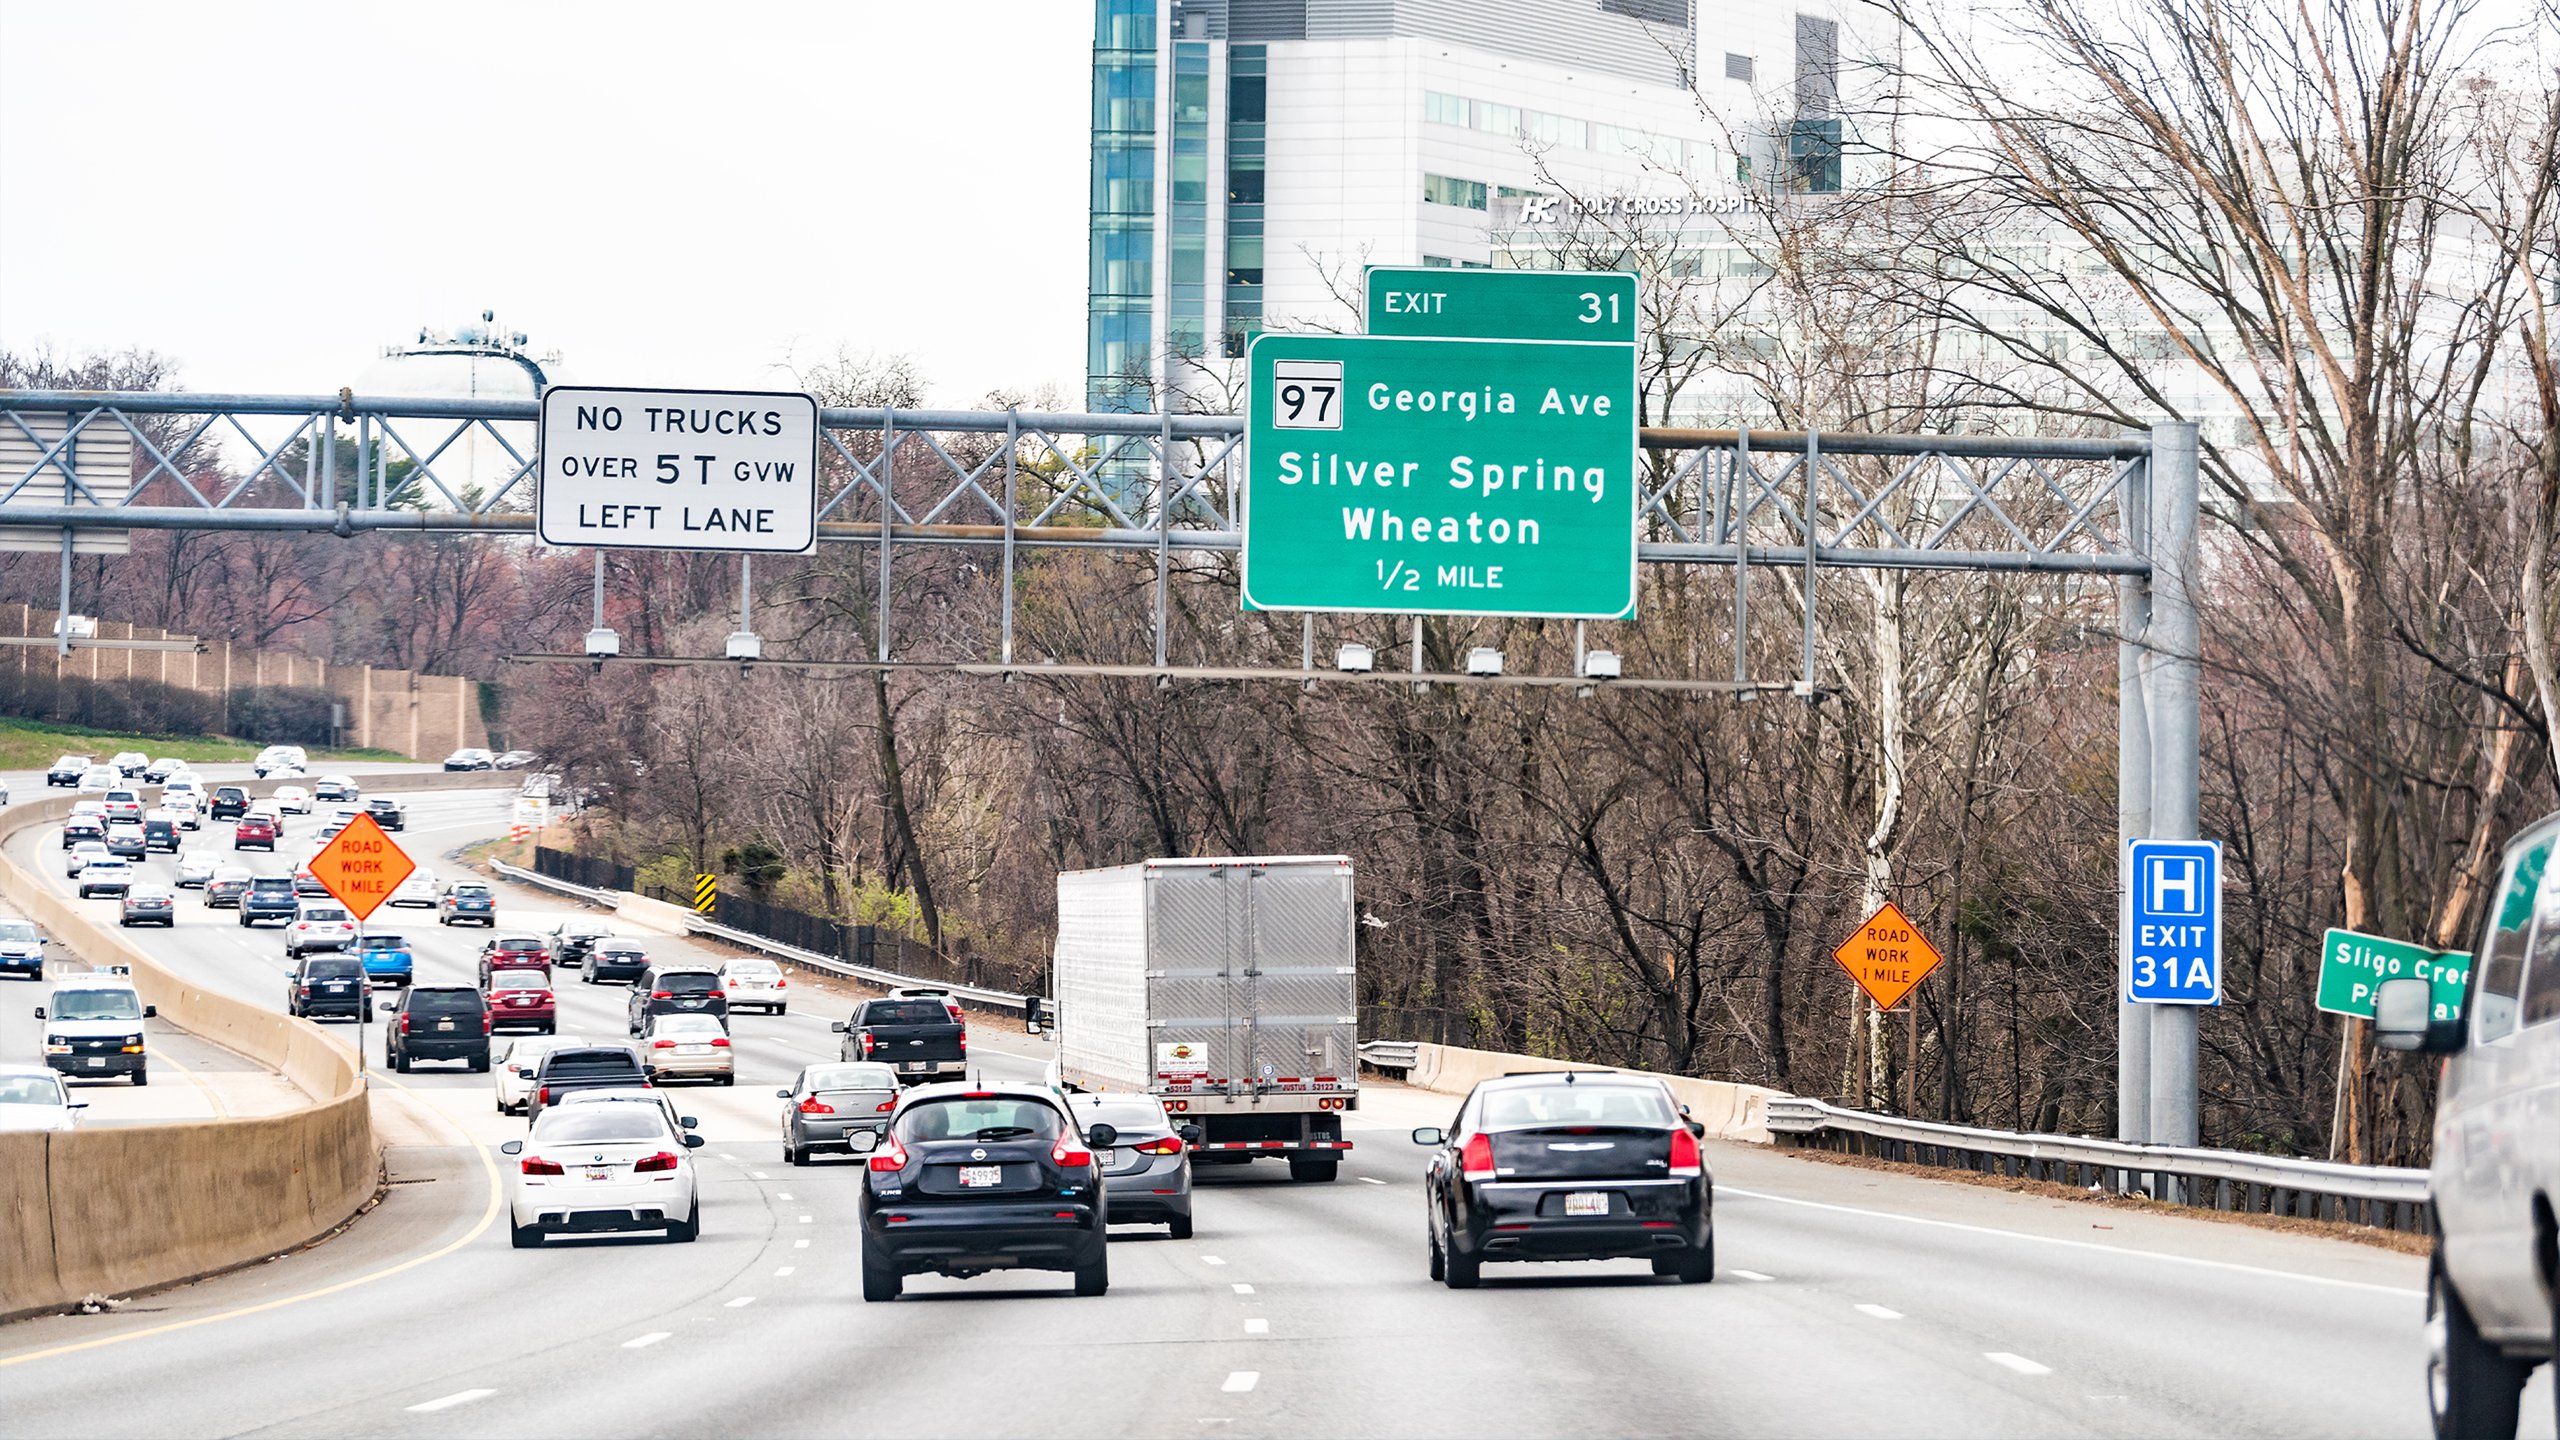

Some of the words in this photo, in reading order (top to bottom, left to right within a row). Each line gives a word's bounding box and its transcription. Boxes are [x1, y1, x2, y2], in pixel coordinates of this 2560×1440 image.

[1520, 197, 1561, 223] HC
[1569, 197, 1616, 214] HOLY
[1622, 197, 1682, 215] CROSS
[1385, 291, 1447, 314] EXIT
[1578, 292, 1620, 324] 31
[1281, 384, 1336, 422] 97
[1367, 383, 1516, 422] Georgia
[1539, 388, 1612, 417] Ave
[577, 406, 623, 432] NO
[644, 407, 782, 436] TRUCKS
[561, 456, 638, 478] OVER
[656, 454, 680, 485] 5
[694, 455, 716, 485] T
[734, 461, 795, 483] GVW
[1278, 451, 1420, 488] Silver
[1448, 455, 1605, 504] Spring
[579, 504, 662, 530] LEFT
[683, 507, 774, 533] LANE
[1342, 507, 1540, 545] Wheaton
[1437, 565, 1504, 588] MILE
[342, 840, 383, 854] ROAD
[342, 860, 383, 873] WORK
[341, 880, 346, 893] 1
[351, 880, 385, 894] MILE
[2153, 860, 2195, 911] H
[1867, 928, 1910, 943] ROAD
[2141, 925, 2207, 948] EXIT
[1866, 948, 1909, 963] WORK
[2335, 942, 2402, 978] Sligo
[2414, 959, 2470, 985] Cree
[1863, 968, 1868, 980] 1
[1874, 968, 1910, 983] MILE
[2134, 955, 2213, 989] 31A
[1170, 1085, 1192, 1093] 53123
[1282, 1083, 1307, 1092] JUSTUS
[1312, 1083, 1334, 1091] 53123
